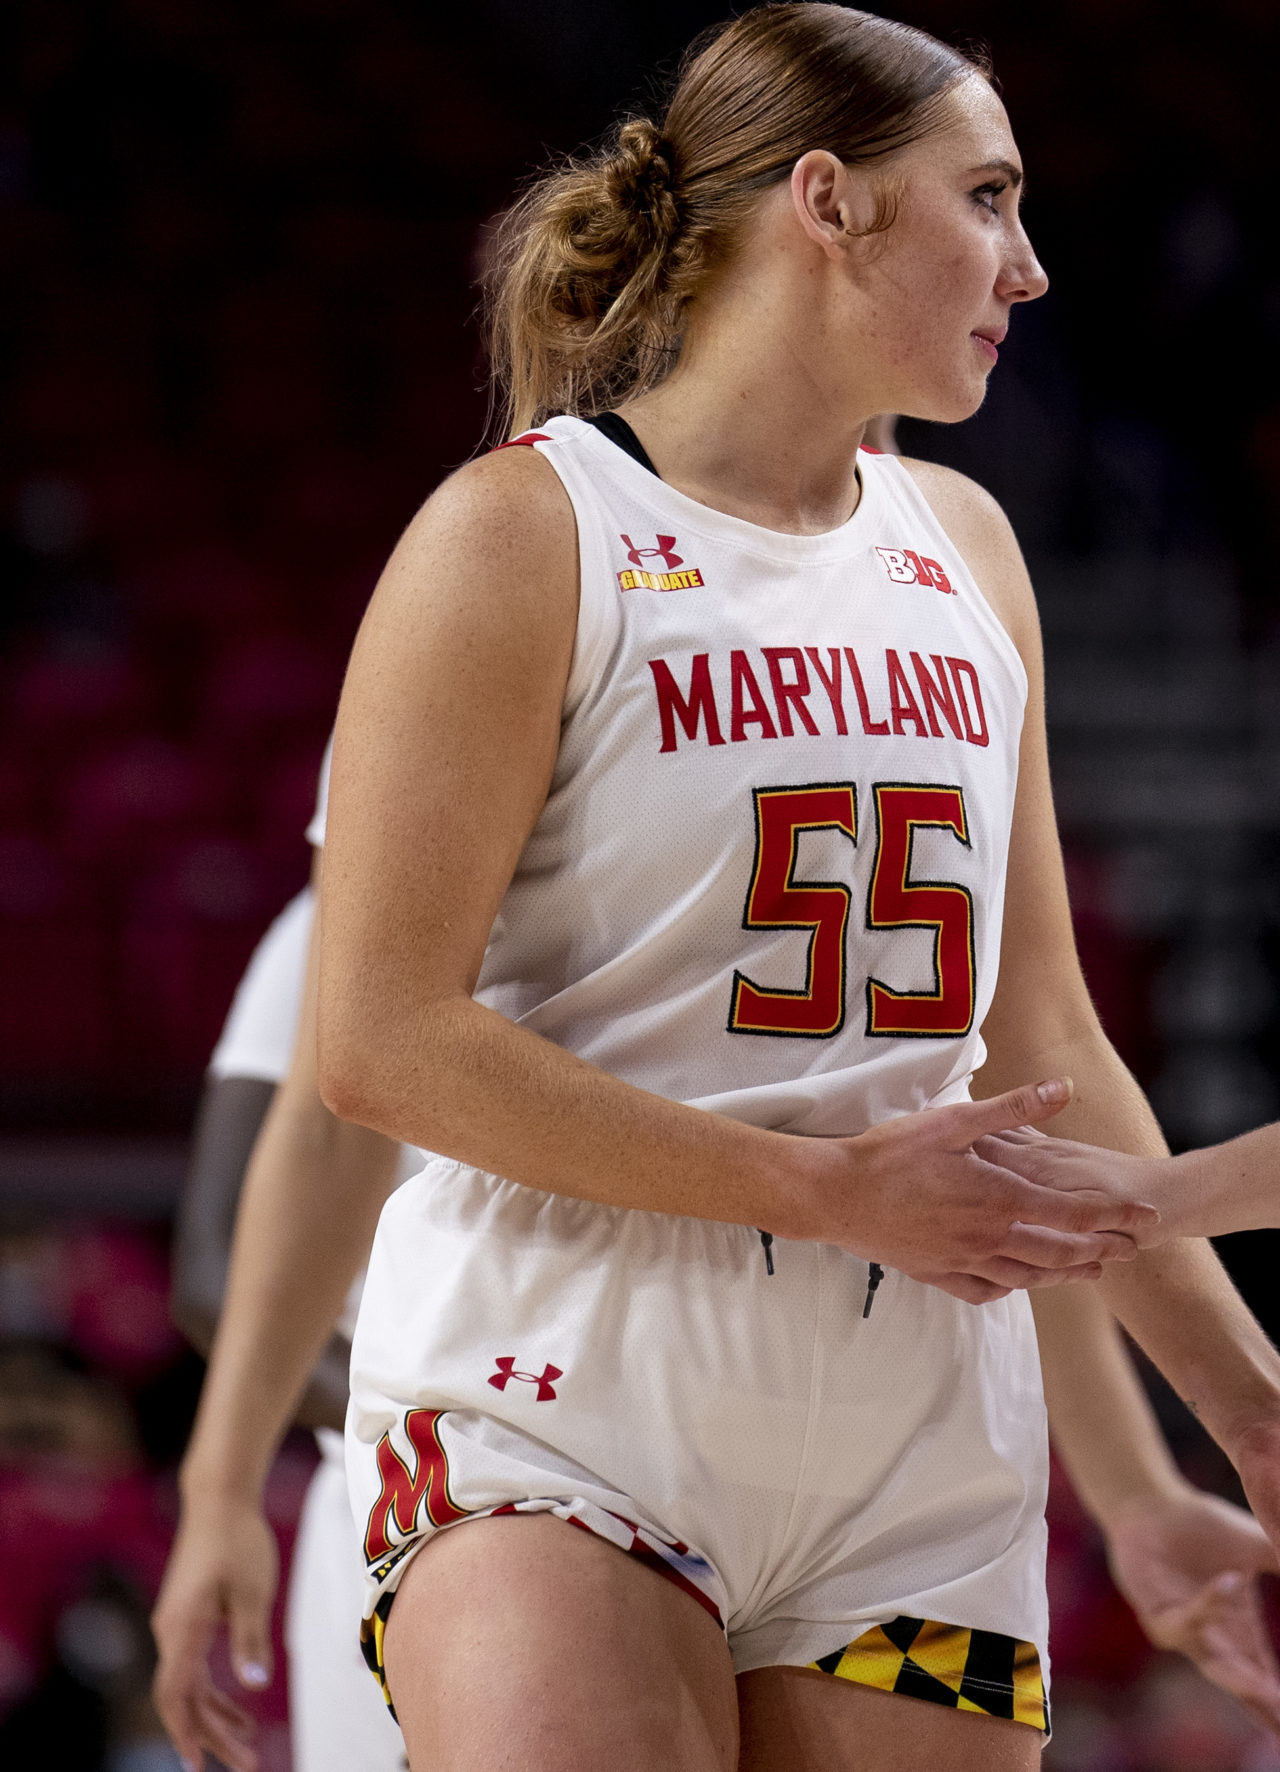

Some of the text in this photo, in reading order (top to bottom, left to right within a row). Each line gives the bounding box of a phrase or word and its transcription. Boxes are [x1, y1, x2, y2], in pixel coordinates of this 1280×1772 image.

[647, 646, 990, 754] MARYLAND
[726, 780, 977, 1040] 55
[363, 1407, 474, 1568] M
